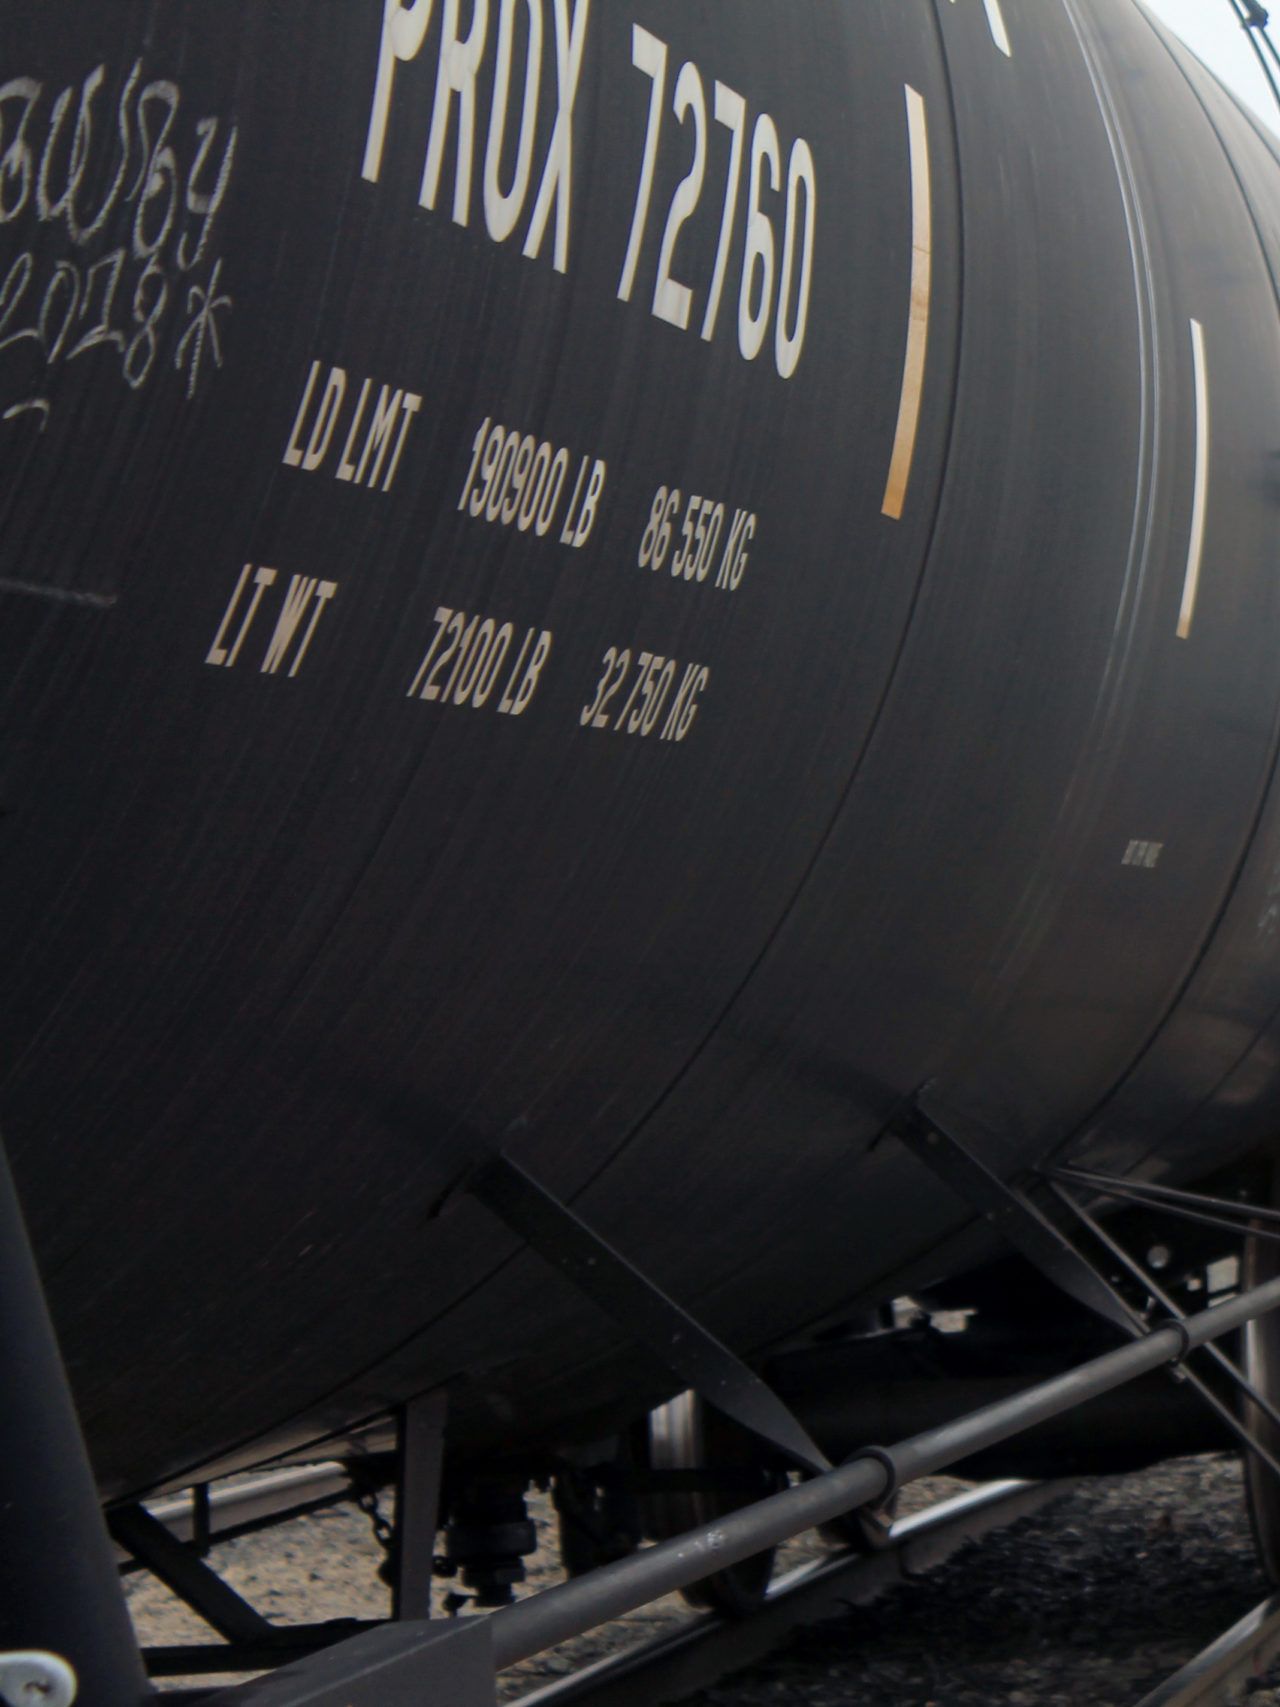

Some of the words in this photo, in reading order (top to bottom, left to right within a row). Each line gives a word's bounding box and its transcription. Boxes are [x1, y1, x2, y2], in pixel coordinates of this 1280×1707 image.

[361, 0, 590, 274] PROX
[617, 22, 816, 379] 72760
[282, 360, 347, 471] LD
[335, 378, 423, 492] LMT
[457, 416, 569, 536] 190900
[559, 455, 606, 548] LB
[715, 508, 757, 591] KG
[204, 563, 278, 667] LT
[260, 574, 338, 678] WT
[406, 606, 514, 708] 72100
[497, 627, 552, 715] LB
[659, 662, 709, 742] KG
